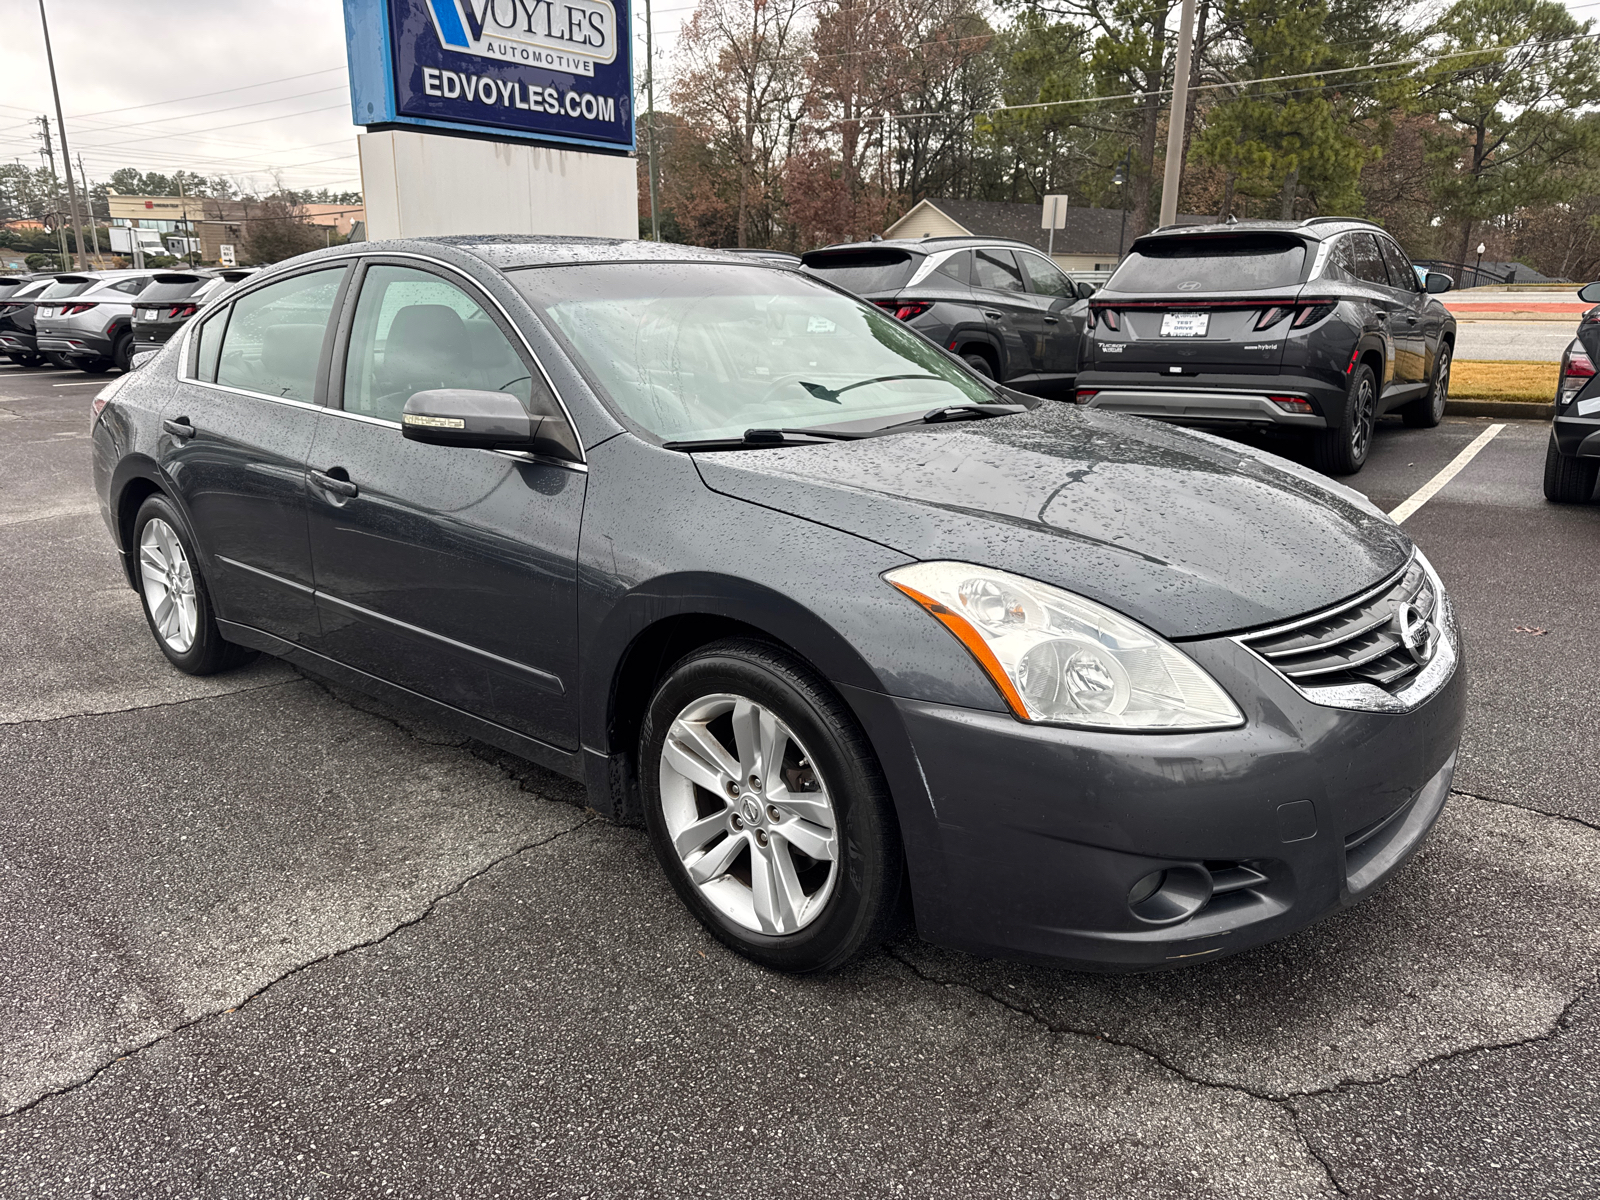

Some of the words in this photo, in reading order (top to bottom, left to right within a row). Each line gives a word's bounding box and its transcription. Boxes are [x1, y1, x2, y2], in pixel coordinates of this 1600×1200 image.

[459, 0, 606, 48] VOYLES
[487, 42, 591, 72] AUTOMOTIVE
[422, 67, 615, 122] EDVOYLES.COM
